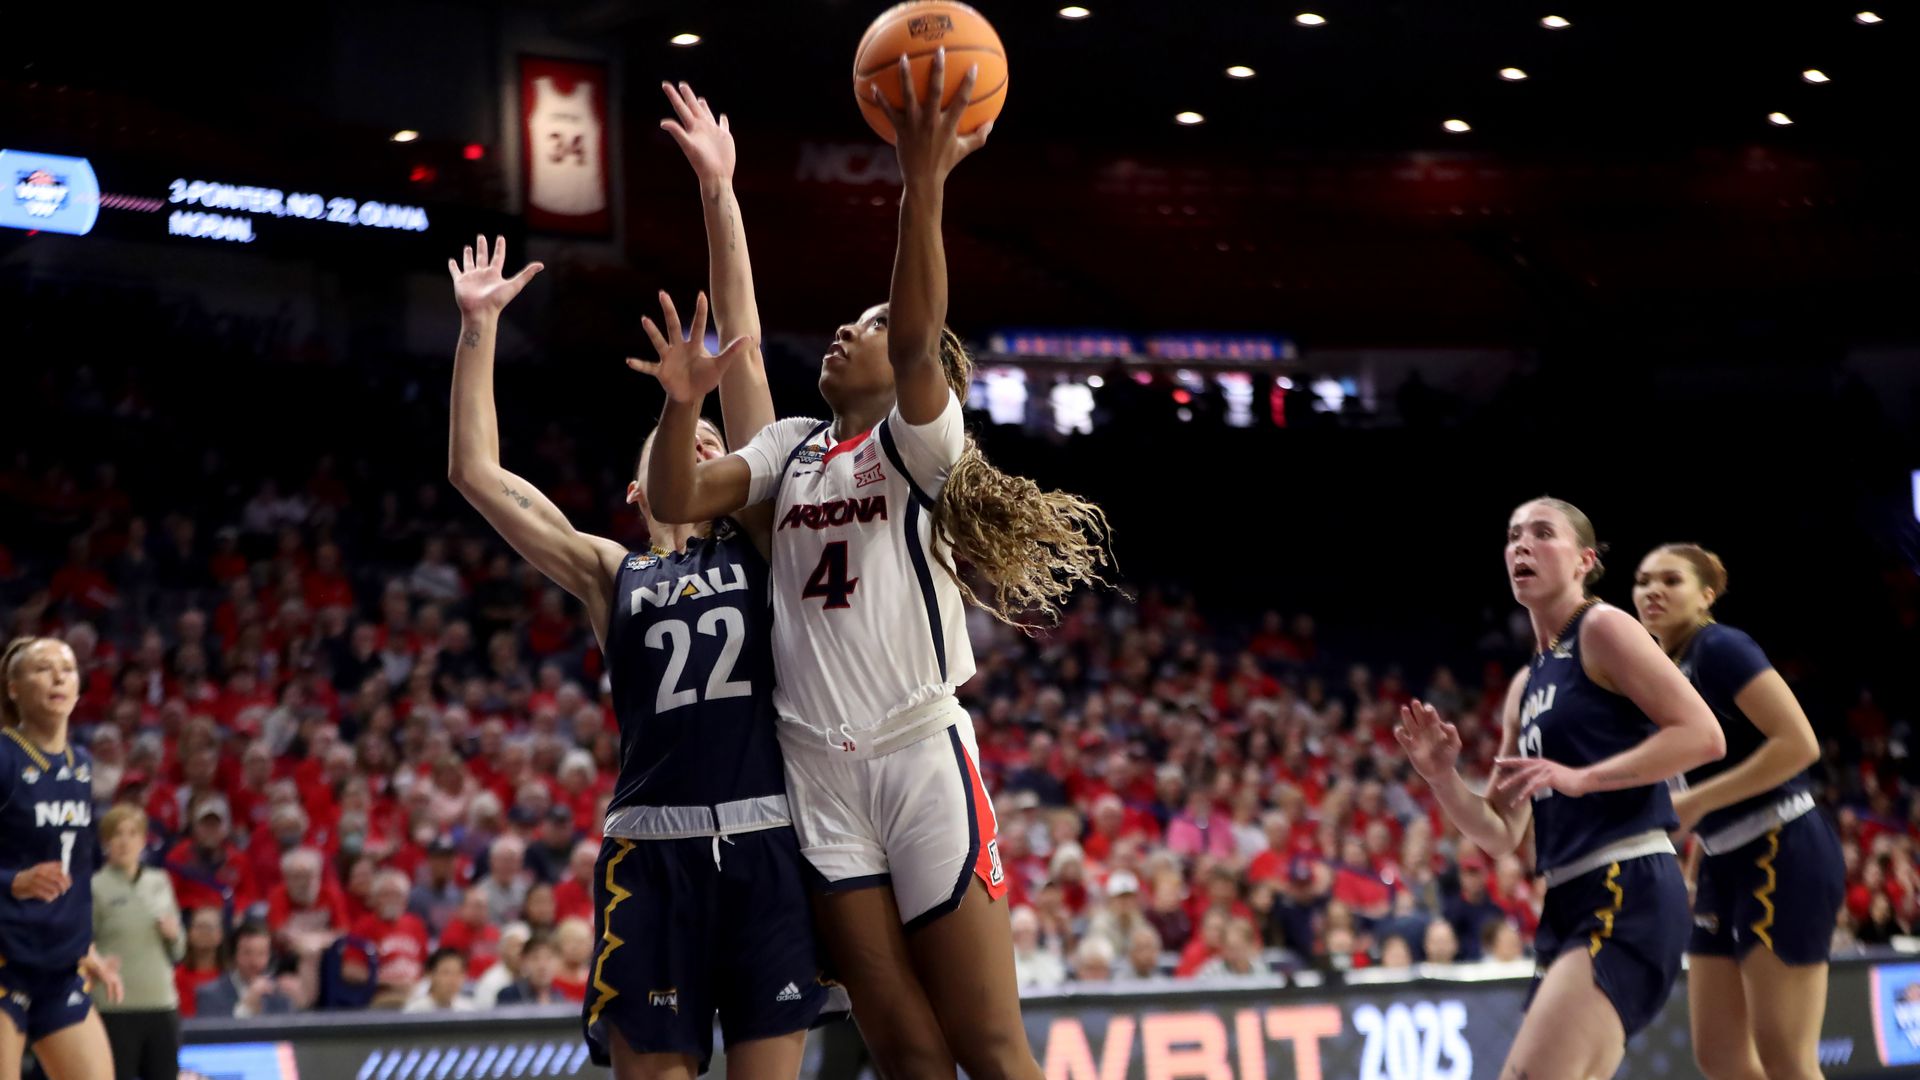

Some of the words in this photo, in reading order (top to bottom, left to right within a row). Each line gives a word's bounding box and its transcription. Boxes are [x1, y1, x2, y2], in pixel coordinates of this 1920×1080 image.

[549, 132, 587, 168] 34
[796, 141, 901, 185] NCA
[777, 495, 888, 531] ARIZONA
[630, 563, 749, 615] NAU
[801, 540, 860, 611] 4
[643, 605, 753, 715] 22
[34, 801, 92, 827] NAU
[60, 830, 77, 877] 1
[776, 993, 802, 1002] adidas
[1352, 1000, 1474, 1080] 2025
